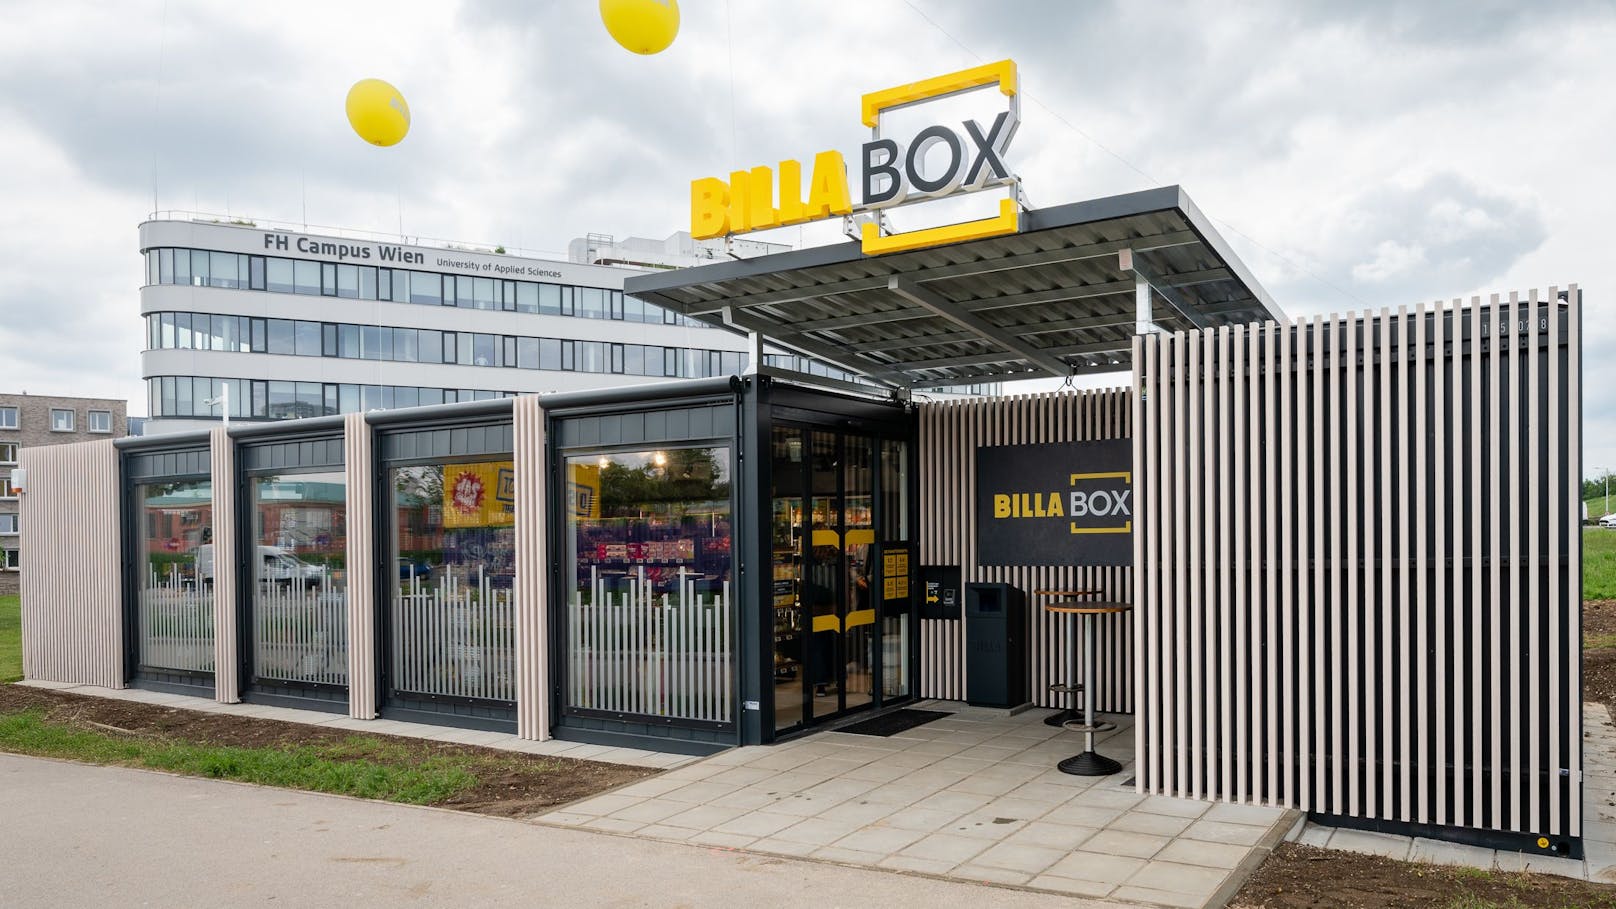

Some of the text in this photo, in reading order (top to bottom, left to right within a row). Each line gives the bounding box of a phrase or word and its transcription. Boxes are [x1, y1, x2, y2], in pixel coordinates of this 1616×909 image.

[691, 110, 1013, 241] BILLA BOX
[264, 233, 425, 265] FH Campus Wien
[436, 257, 562, 279] University of Applied Sciences
[994, 489, 1131, 519] BILLA BOX
